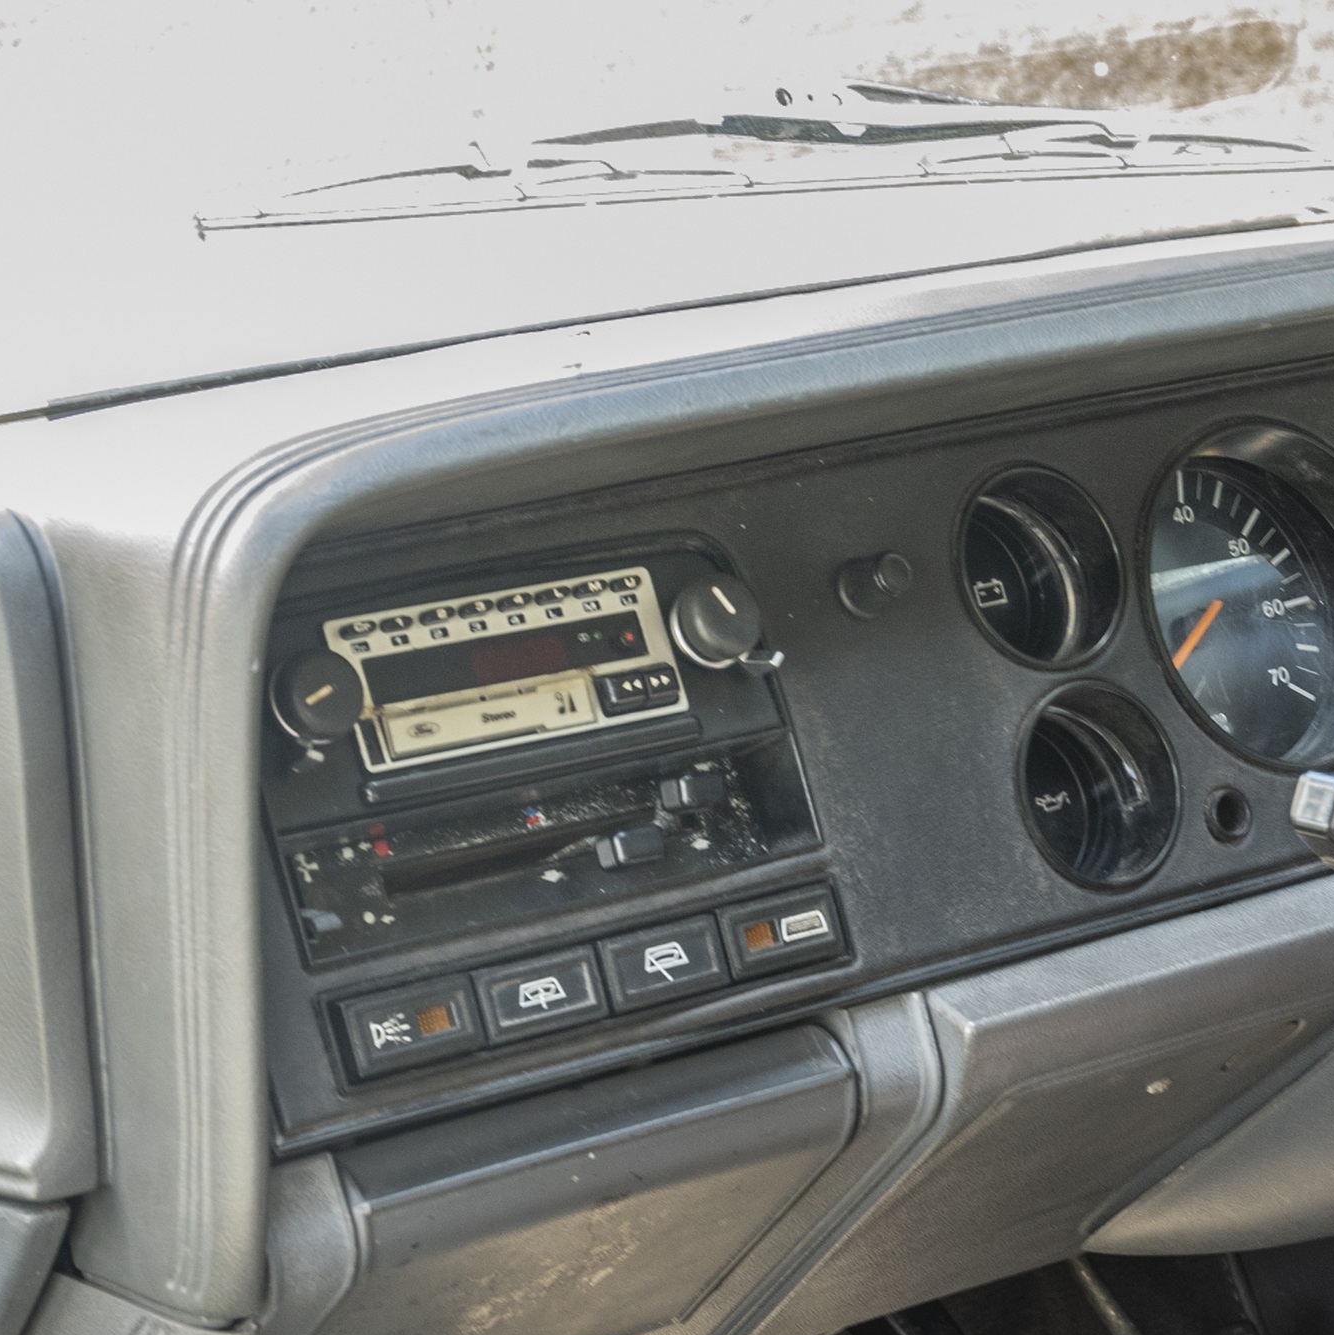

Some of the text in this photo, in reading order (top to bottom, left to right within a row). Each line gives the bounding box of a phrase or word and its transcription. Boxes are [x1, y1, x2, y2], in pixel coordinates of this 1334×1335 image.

[1172, 505, 1195, 524] 40
[1227, 538, 1251, 557] 50
[475, 601, 486, 612] 3
[513, 594, 524, 604] 4
[553, 588, 563, 598] L
[587, 582, 602, 592] M
[623, 577, 636, 588] U
[1262, 598, 1285, 618] 60
[1267, 666, 1291, 687] 70
[482, 710, 516, 723] Stereo
